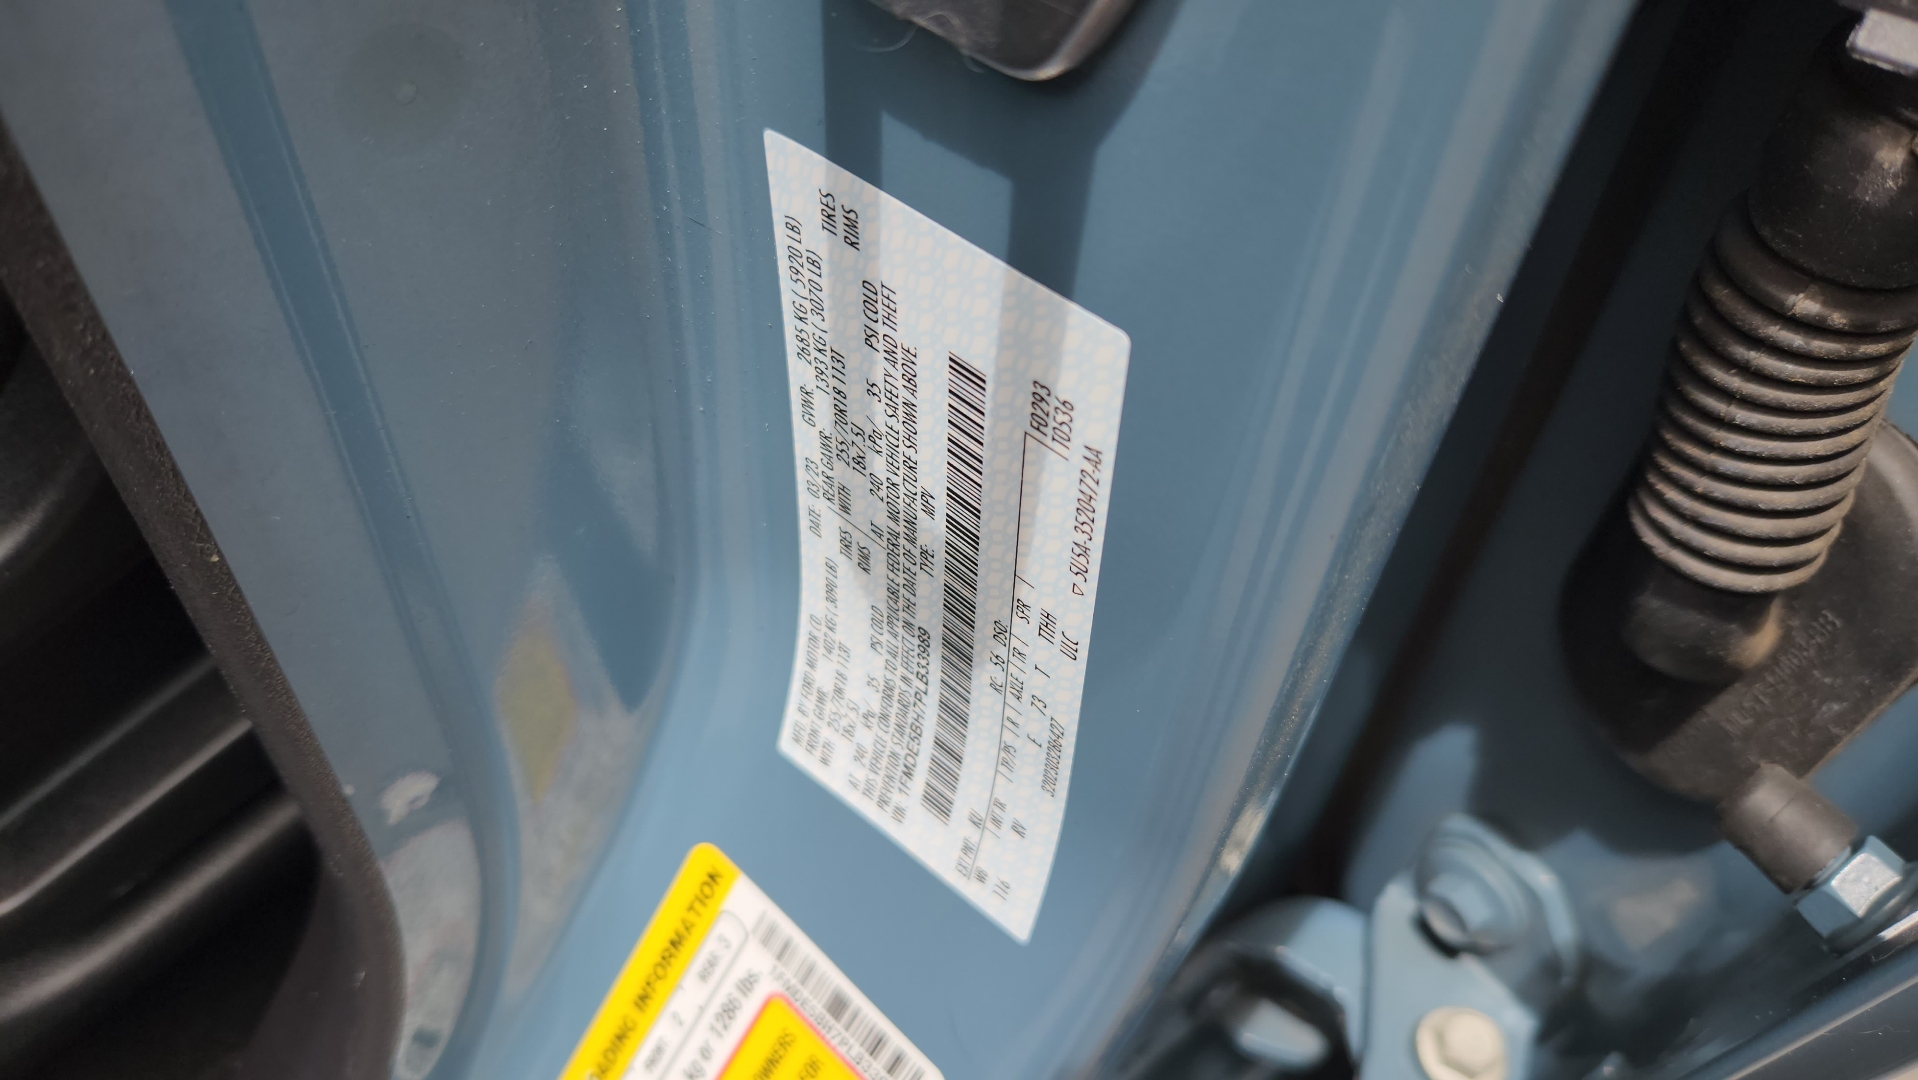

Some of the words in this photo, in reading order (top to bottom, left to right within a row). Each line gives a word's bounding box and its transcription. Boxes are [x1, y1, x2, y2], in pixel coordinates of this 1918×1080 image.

[819, 188, 837, 236] TIRES
[841, 205, 860, 251] RIMS
[784, 215, 802, 244] LB)
[788, 246, 806, 288] 5920
[805, 249, 823, 278] LB)
[792, 301, 808, 325] KG
[808, 279, 825, 322] 3070
[862, 280, 879, 323] COLD
[881, 281, 897, 332] THEFT
[794, 325, 812, 366] 2685
[812, 334, 827, 357] KG
[864, 324, 880, 353] PSI
[883, 334, 898, 371] AND
[814, 357, 830, 395] 1393
[830, 346, 846, 385] 113T
[901, 342, 917, 399] ABOVE.
[799, 384, 816, 427] GVWR:
[866, 378, 881, 403] 35
[883, 367, 899, 423] SAFETY
[902, 395, 917, 454] SHOWN
[1030, 380, 1051, 436] F0293
[1052, 396, 1074, 449] T0536
[832, 387, 851, 468] 255/70R18
[866, 415, 884, 458] kPa/
[819, 428, 834, 471] GAWR:
[851, 421, 866, 477] 18x7.5J
[885, 421, 900, 477] VEHICLE
[805, 457, 821, 499] 03/23
[820, 471, 835, 505] REAR
[870, 473, 883, 503] 240
[838, 482, 851, 516] WITH
[886, 479, 900, 526] MOTOR
[902, 447, 917, 548] MANUFACTURE
[920, 486, 935, 520] MPV
[1069, 444, 1103, 583] 5U5A-3520472-AA
[808, 504, 822, 537] DATE:
[870, 520, 884, 540] AT
[839, 525, 852, 560] TIRES
[887, 524, 900, 577] FEDERAL
[903, 543, 917, 563] OF
[825, 556, 838, 578] LB)
[920, 543, 934, 576] TYPE:
[825, 577, 838, 607] 3090
[903, 561, 917, 596] DATE
[871, 604, 884, 635] COLD
[887, 573, 900, 641] APPLICABLE
[902, 591, 916, 618] THE
[1016, 598, 1031, 623] SPR
[809, 613, 822, 630] CO.
[825, 614, 837, 632] KG
[902, 615, 916, 637] ON
[993, 619, 1008, 646] DSO:
[1038, 607, 1057, 644] TTHH
[806, 630, 820, 670] MOTOR
[822, 631, 835, 661] 1402
[837, 639, 851, 669] 113T
[841, 697, 860, 741] 18x7.5J
[857, 541, 871, 574] RIMS
[870, 636, 883, 655] PSI
[885, 638, 899, 659] ALL
[900, 633, 915, 674] EFFECT
[1013, 646, 1026, 663] TR
[1060, 630, 1079, 659] ULC
[884, 659, 897, 673] TO
[990, 650, 1005, 671] 56
[801, 669, 815, 699] FORD
[867, 672, 880, 691] 35
[900, 672, 913, 687] IN
[990, 675, 1003, 694] RC:
[1009, 672, 1024, 701] AXLE
[797, 698, 808, 716] BY
[827, 669, 847, 731] 255/70R18
[876, 674, 897, 732] CONFORMS
[898, 626, 930, 796] 1FMDE5BH7PLB33989
[1031, 694, 1047, 715] 73
[890, 687, 912, 749] STANDARDS
[805, 720, 820, 755] FRONT
[819, 737, 835, 765] WITH
[854, 742, 868, 766] 240
[868, 735, 886, 774] VEHICLE
[1001, 740, 1016, 771] TP/PS
[1041, 715, 1065, 796] 3202303286427
[848, 773, 860, 790] AT
[863, 777, 877, 800] THIS
[876, 748, 902, 812] PREVENTION
[890, 801, 908, 823] VIN:
[968, 806, 983, 828] KU
[990, 810, 1004, 828] INT
[993, 797, 1007, 811] TR
[1011, 816, 1027, 837] RV
[955, 855, 971, 876] EXT
[973, 865, 988, 883] WB
[634, 865, 723, 1013] INFORMATION
[709, 992, 742, 1038] 1286
